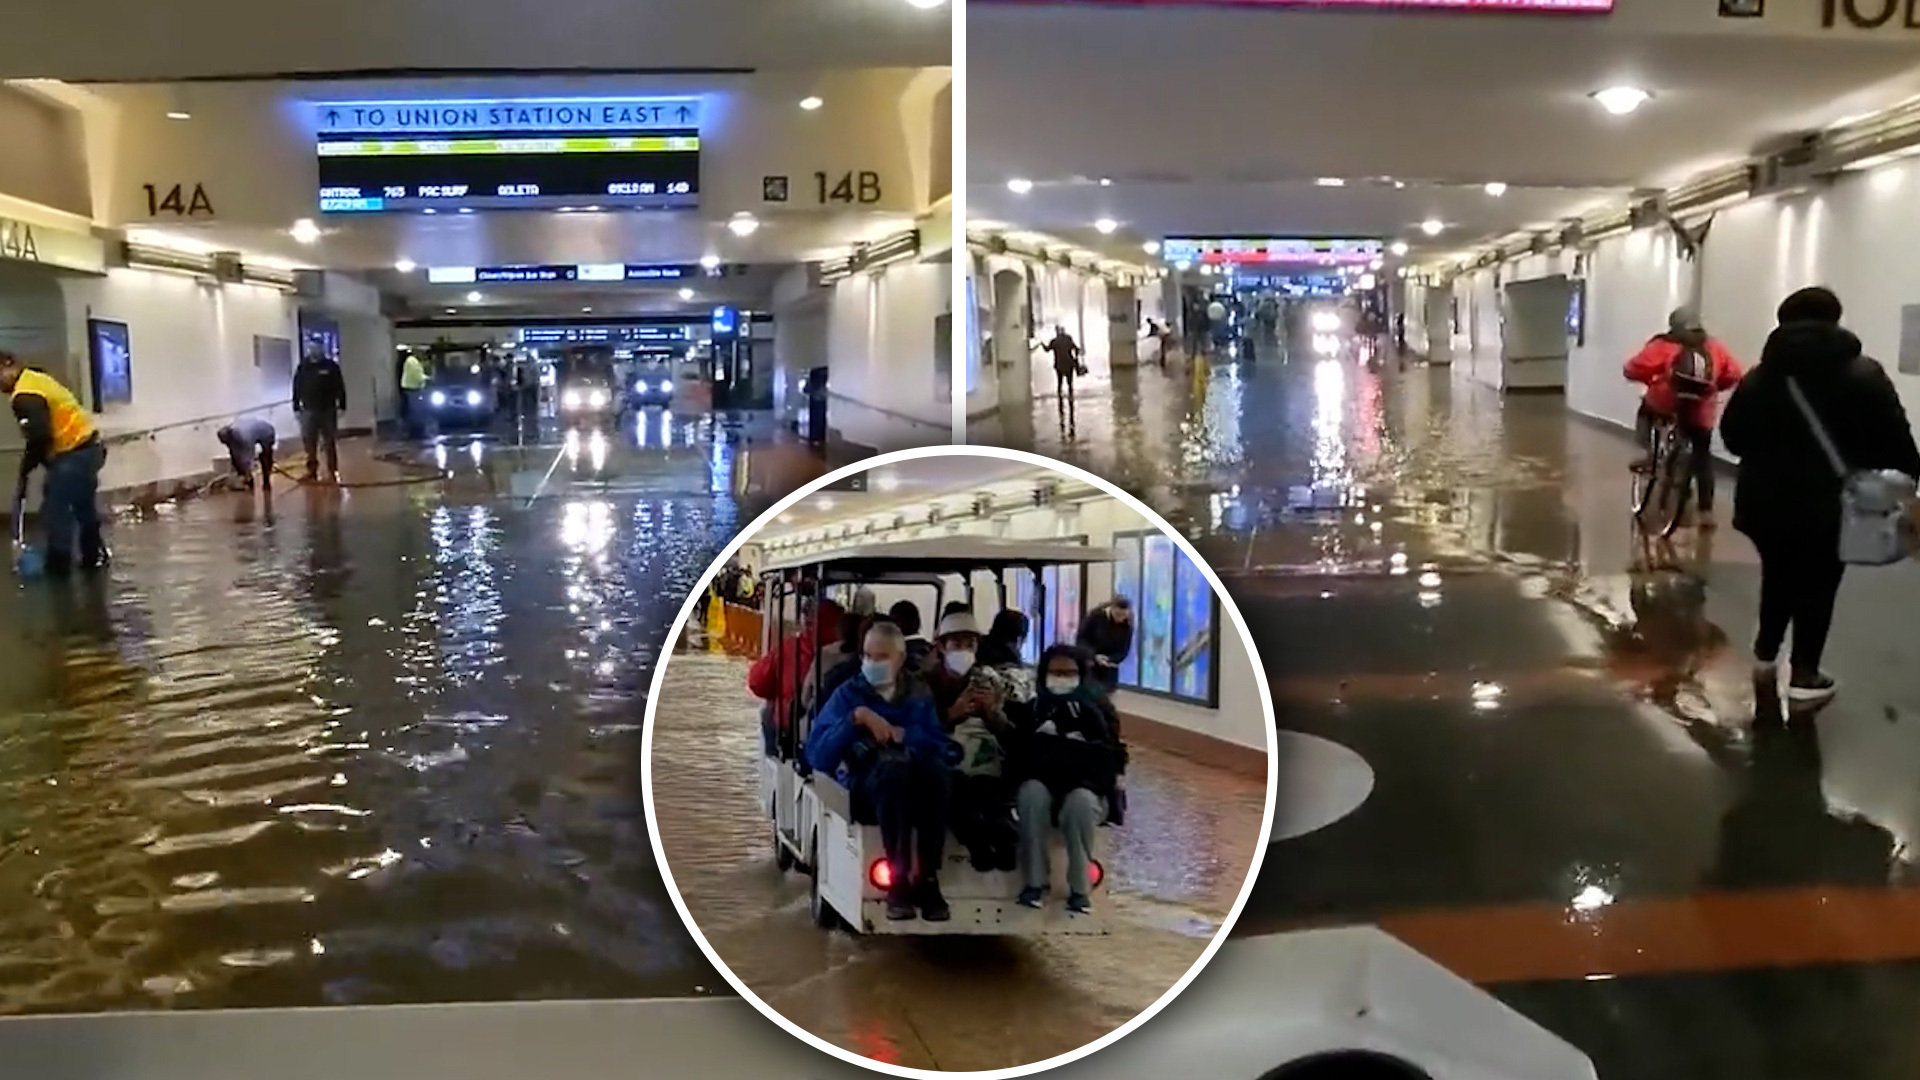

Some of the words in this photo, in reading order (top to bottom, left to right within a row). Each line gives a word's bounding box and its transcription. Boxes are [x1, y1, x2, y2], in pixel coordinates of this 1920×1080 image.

[353, 107, 386, 126] TO
[398, 106, 478, 126] UNION
[489, 105, 592, 125] STATION
[602, 104, 666, 124] EAST
[143, 182, 214, 216] 14A
[814, 170, 881, 203] 14B
[0, 219, 39, 262] 4A
